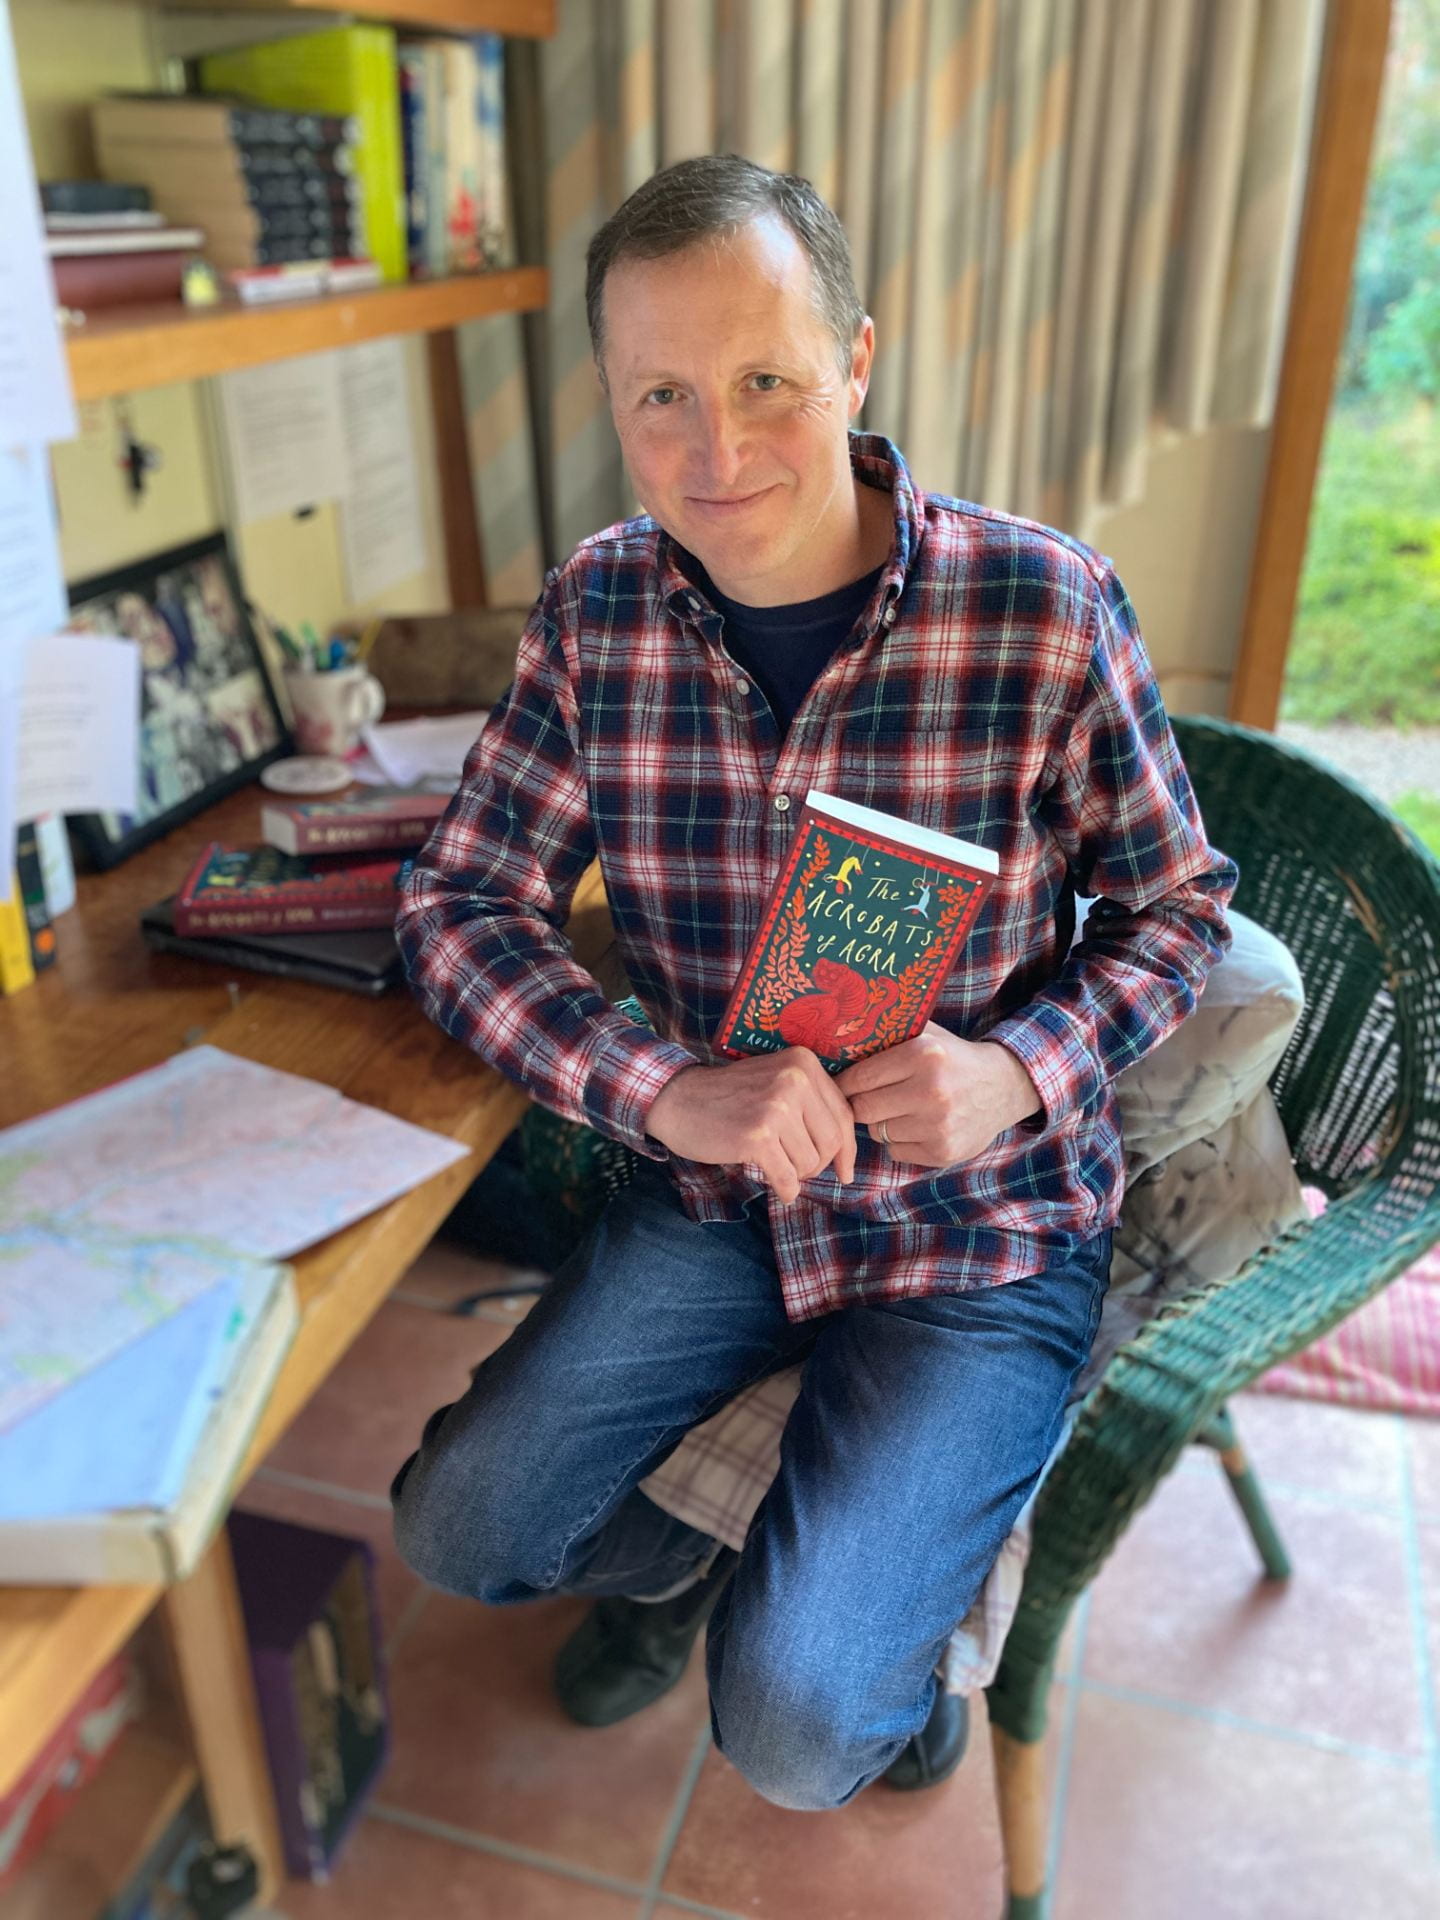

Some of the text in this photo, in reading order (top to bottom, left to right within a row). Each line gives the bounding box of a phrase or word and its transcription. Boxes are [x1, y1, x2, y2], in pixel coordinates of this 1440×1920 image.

[867, 877, 901, 901] The
[807, 889, 934, 947] ACROBATS
[816, 934, 898, 977] of AGRA
